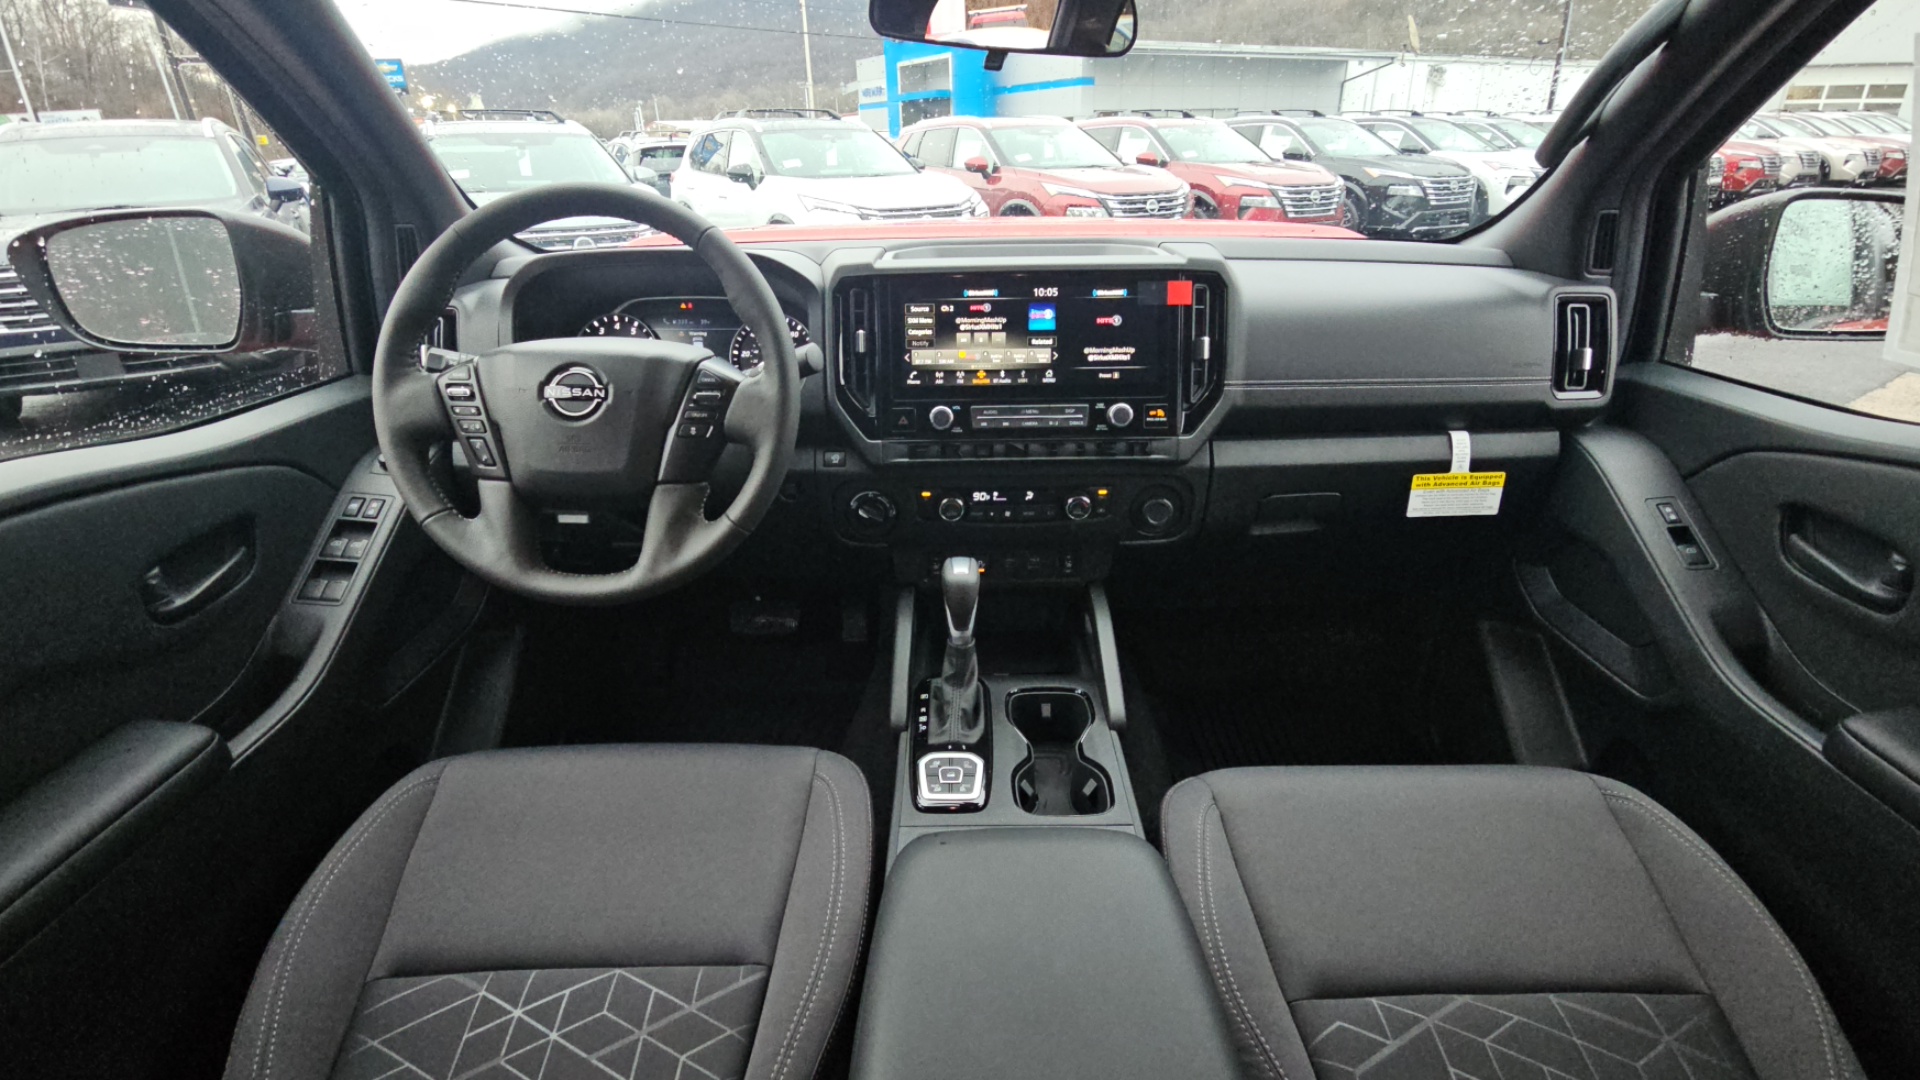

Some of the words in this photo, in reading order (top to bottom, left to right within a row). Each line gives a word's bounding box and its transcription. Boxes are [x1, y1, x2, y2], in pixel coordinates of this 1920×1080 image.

[1033, 287, 1059, 297] 10:05
[910, 305, 930, 313] Source
[614, 321, 620, 330] 4
[599, 326, 605, 335] 3
[630, 326, 637, 335] 5
[907, 328, 933, 336] Categories
[911, 339, 929, 348] Notify
[1031, 338, 1053, 346] Related
[740, 349, 751, 358] 20
[546, 387, 605, 398] NISSAN
